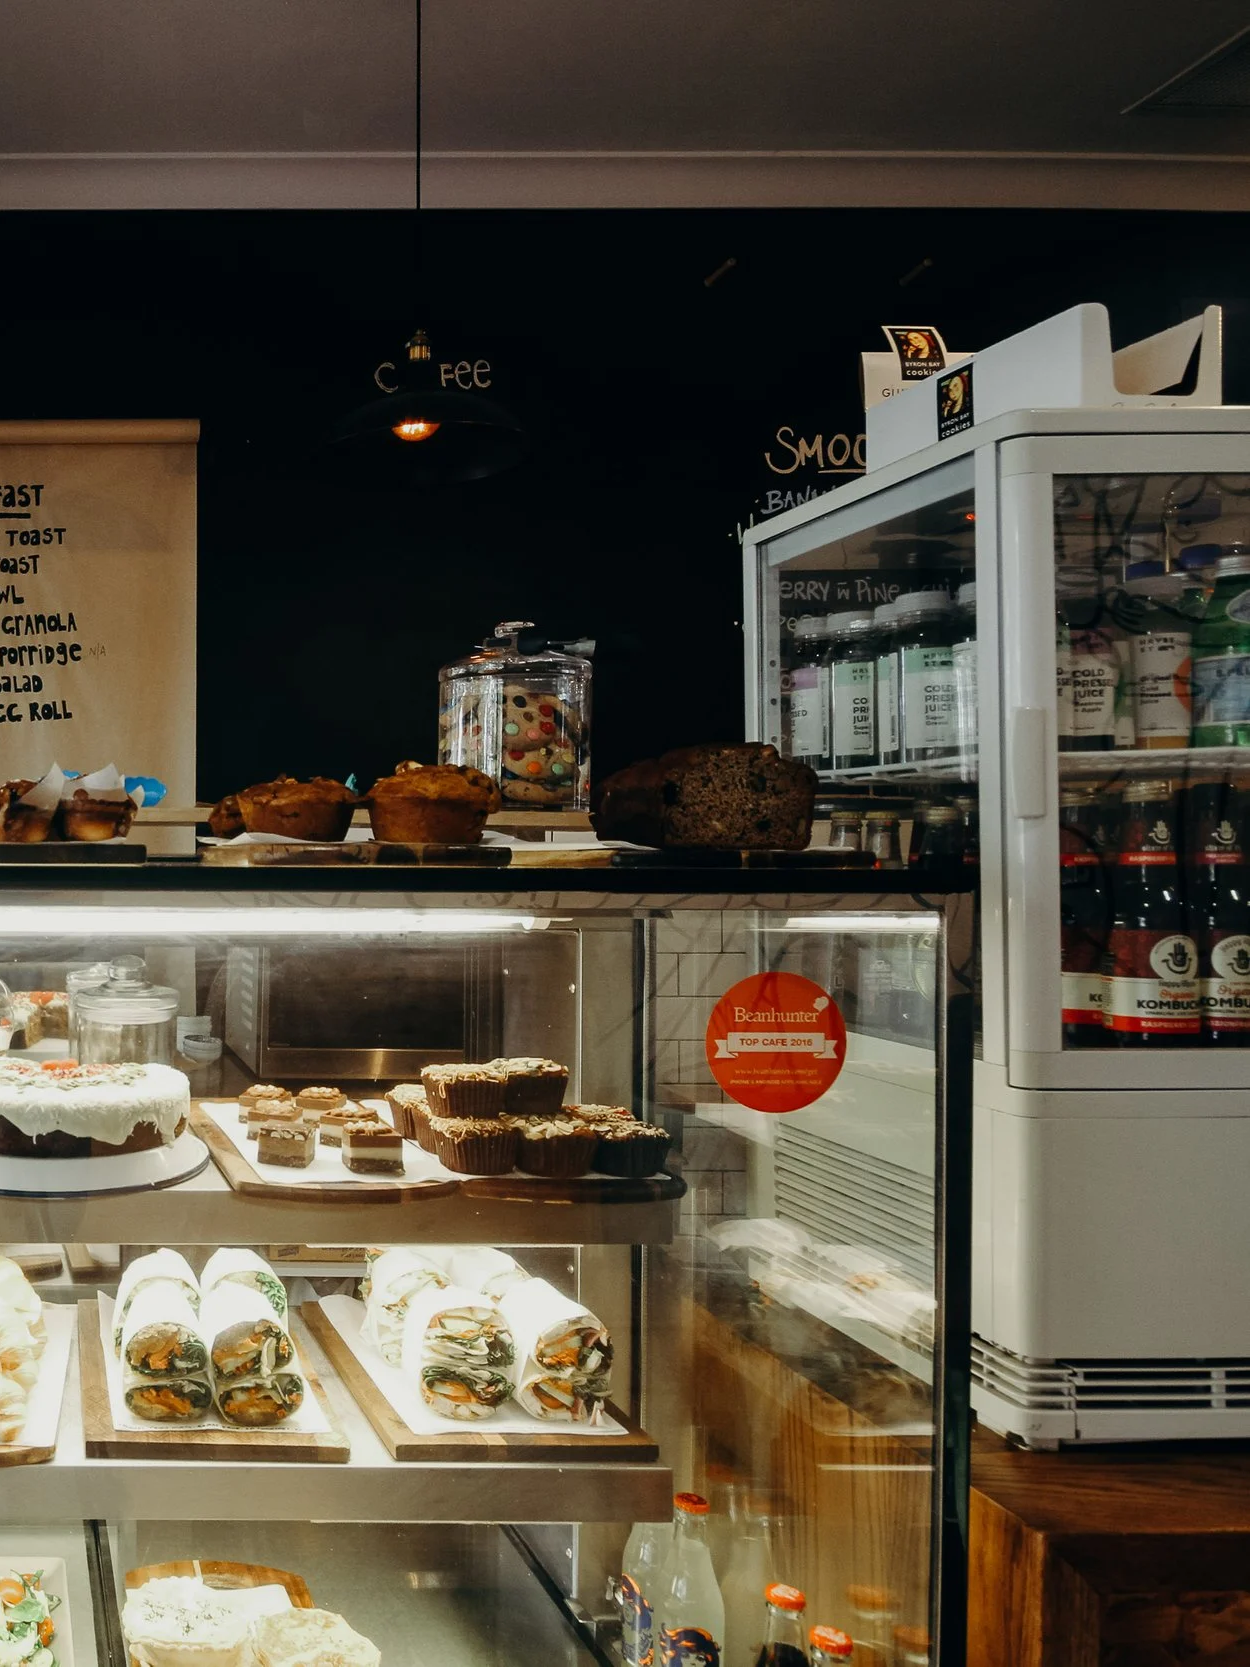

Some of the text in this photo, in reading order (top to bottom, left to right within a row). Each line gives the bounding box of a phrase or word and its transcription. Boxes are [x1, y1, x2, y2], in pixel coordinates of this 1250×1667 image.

[374, 360, 491, 393] CFee
[941, 420, 971, 438] cookies
[733, 1006, 820, 1024] Beanhunter
[739, 1038, 759, 1047] TOP
[762, 1038, 788, 1047] CAFE
